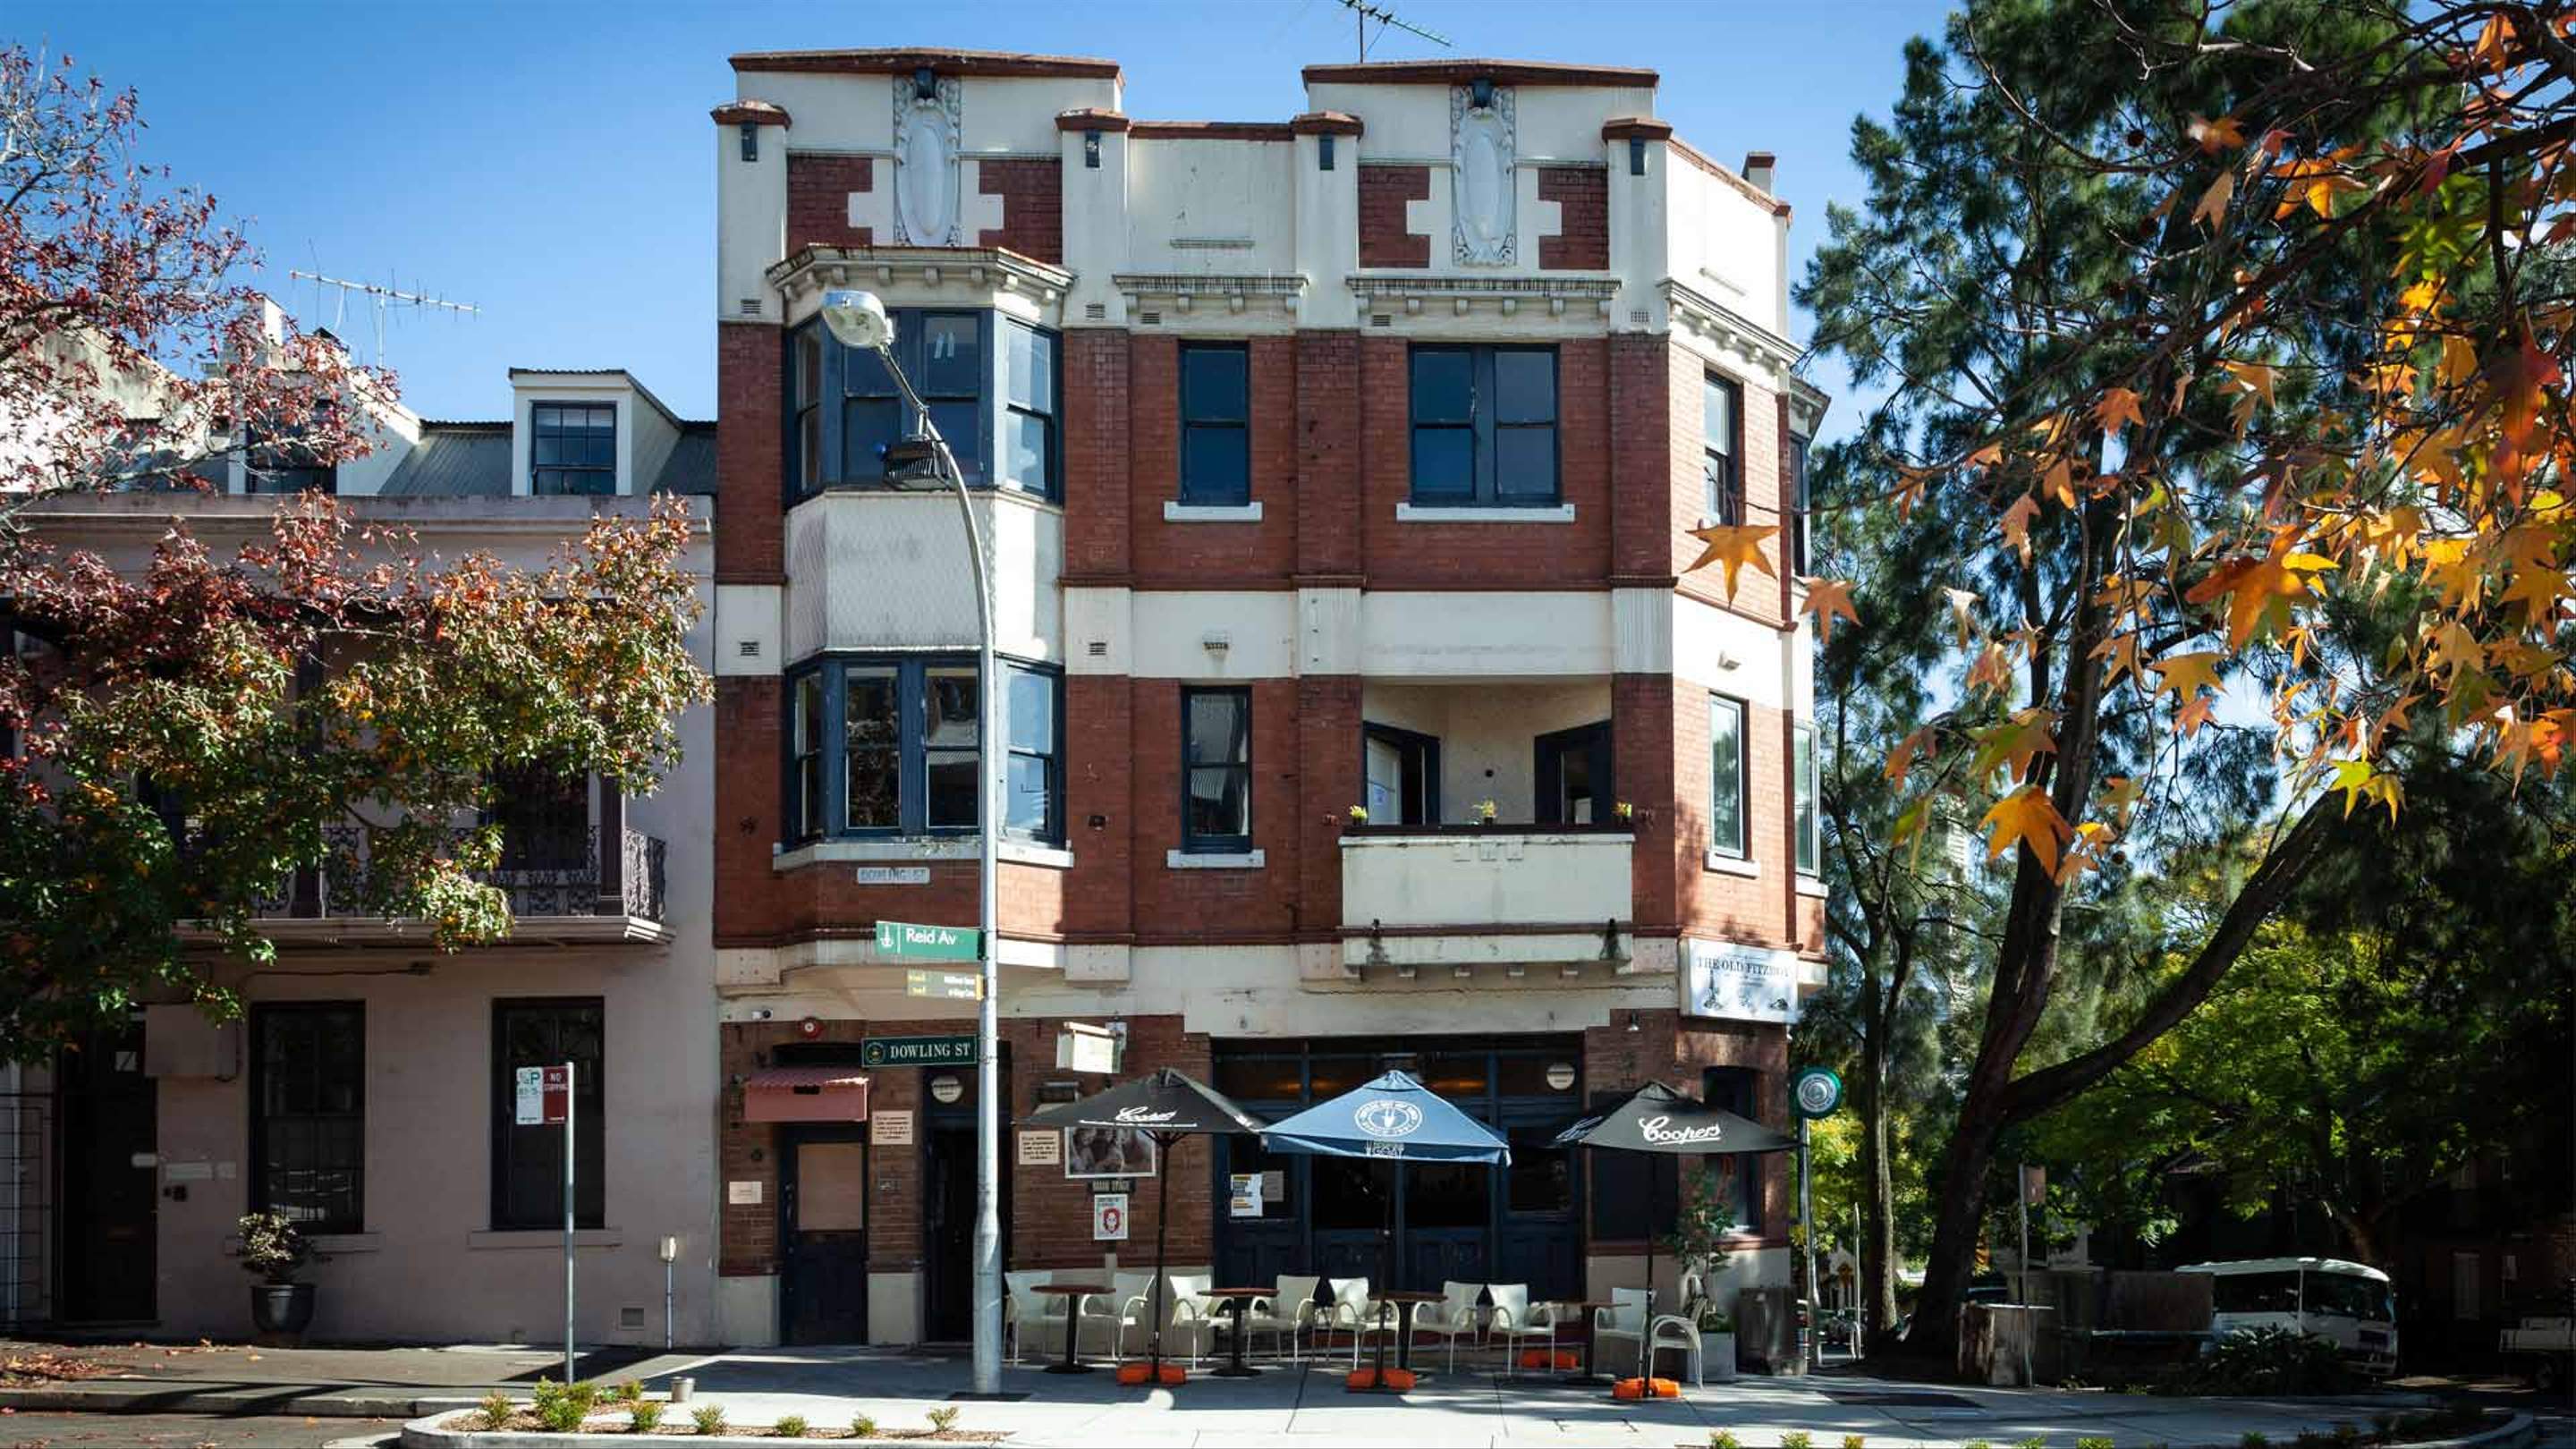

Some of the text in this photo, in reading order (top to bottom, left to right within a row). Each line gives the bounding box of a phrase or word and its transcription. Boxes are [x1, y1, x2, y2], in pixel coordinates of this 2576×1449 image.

[906, 928, 956, 945] Reid Av
[1698, 956, 1720, 970] THE
[1721, 960, 1743, 972] OLD
[889, 1042, 970, 1059] DOWLING ST
[1639, 1116, 1721, 1145] Coopers
